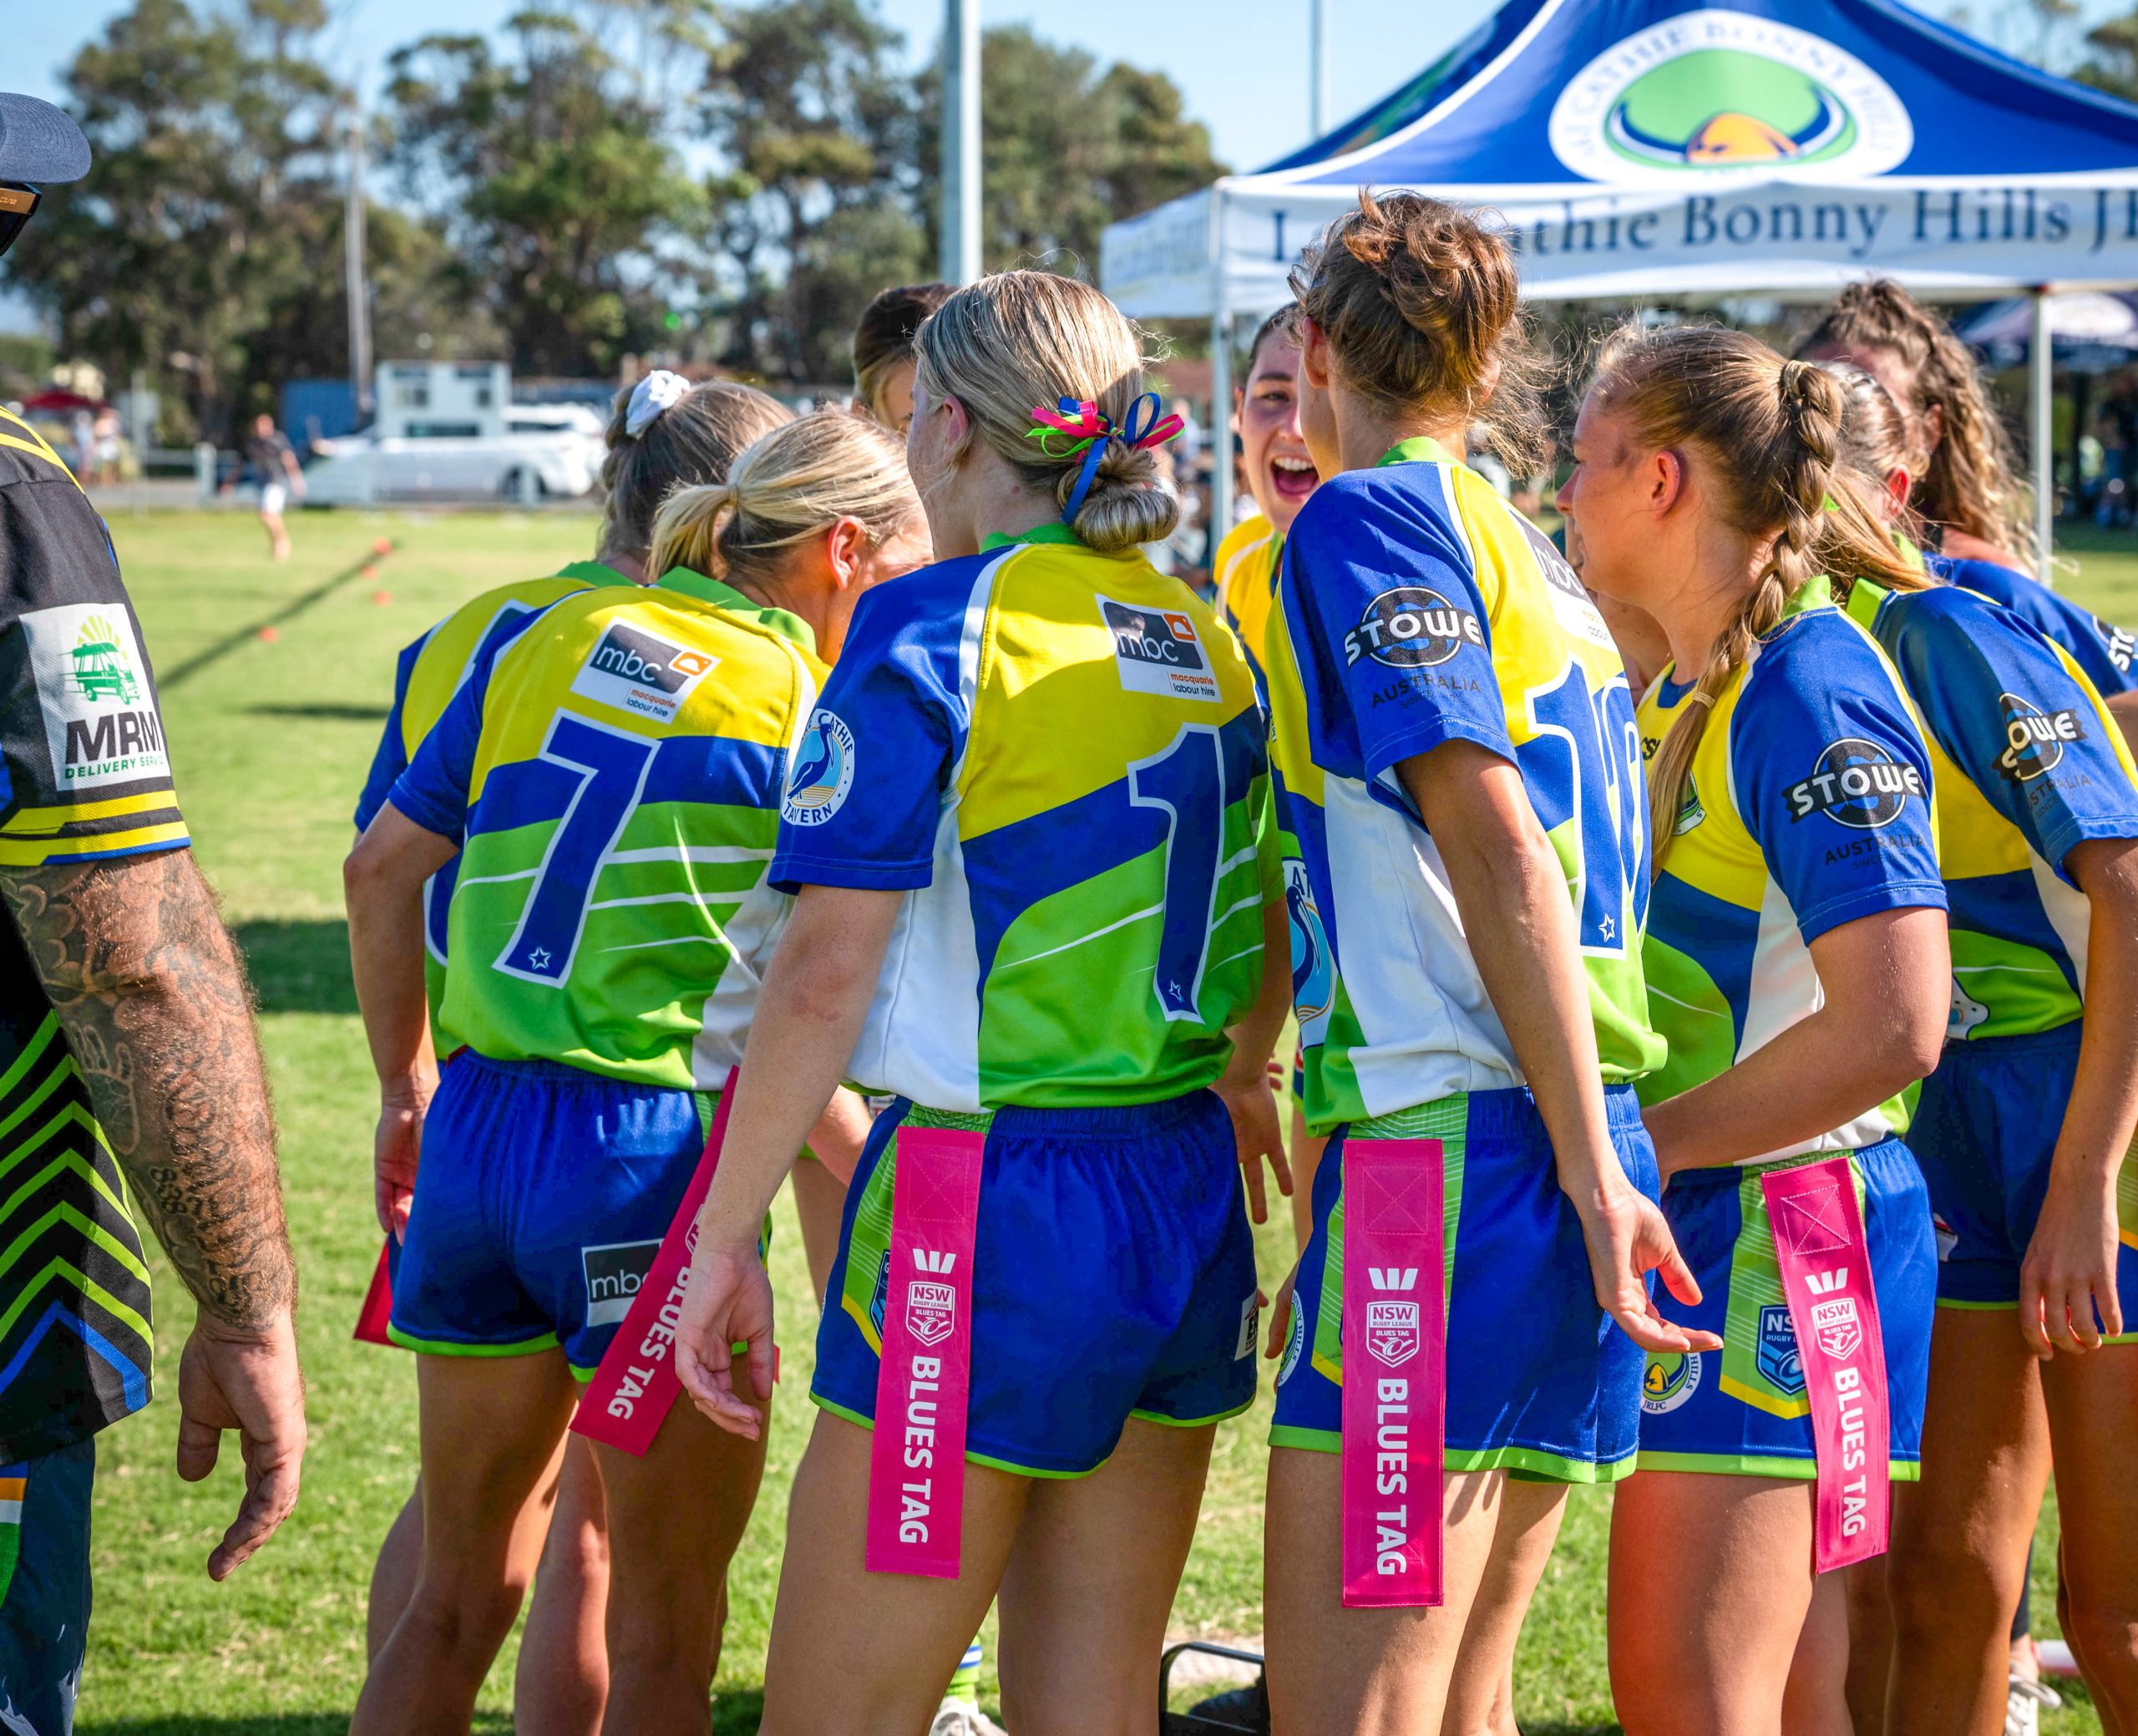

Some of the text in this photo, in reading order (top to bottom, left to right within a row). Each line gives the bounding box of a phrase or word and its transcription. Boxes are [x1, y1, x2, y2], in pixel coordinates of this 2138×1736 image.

[1508, 200, 1660, 253] thie
[1680, 195, 1887, 256] Bonny
[1913, 188, 2071, 241] Hills
[1116, 630, 1179, 662] mbc
[1345, 610, 1482, 666] STOWE
[596, 645, 662, 681] mbc
[1171, 673, 1214, 686] macquarie
[631, 689, 676, 709] macquarie
[1173, 683, 1215, 696] labour hire
[1372, 673, 1482, 708] AUSTRALIA
[626, 697, 669, 717] labour hire
[65, 711, 161, 764] MRM
[818, 712, 853, 756] CATHIE
[65, 758, 136, 779] DELIVERY
[1792, 766, 1919, 816] STOWE
[783, 802, 832, 823] TAVERN
[491, 706, 663, 989] 7
[1826, 833, 1925, 866] AUSTRALIA
[1127, 721, 1226, 1025] 1
[914, 1287, 950, 1302] NSW
[1373, 1307, 1413, 1320] NSW
[1766, 1313, 1795, 1332] NS
[1816, 1303, 1850, 1321] NSW
[607, 1266, 692, 1420] BLUES TAG
[1824, 1327, 1841, 1335] BLUES
[1686, 1356, 1699, 1389] HILLS
[899, 1355, 941, 1544] BLUES TAG
[1835, 1367, 1866, 1536] BLUES TAG
[1376, 1379, 1408, 1575] BLUES TAG
